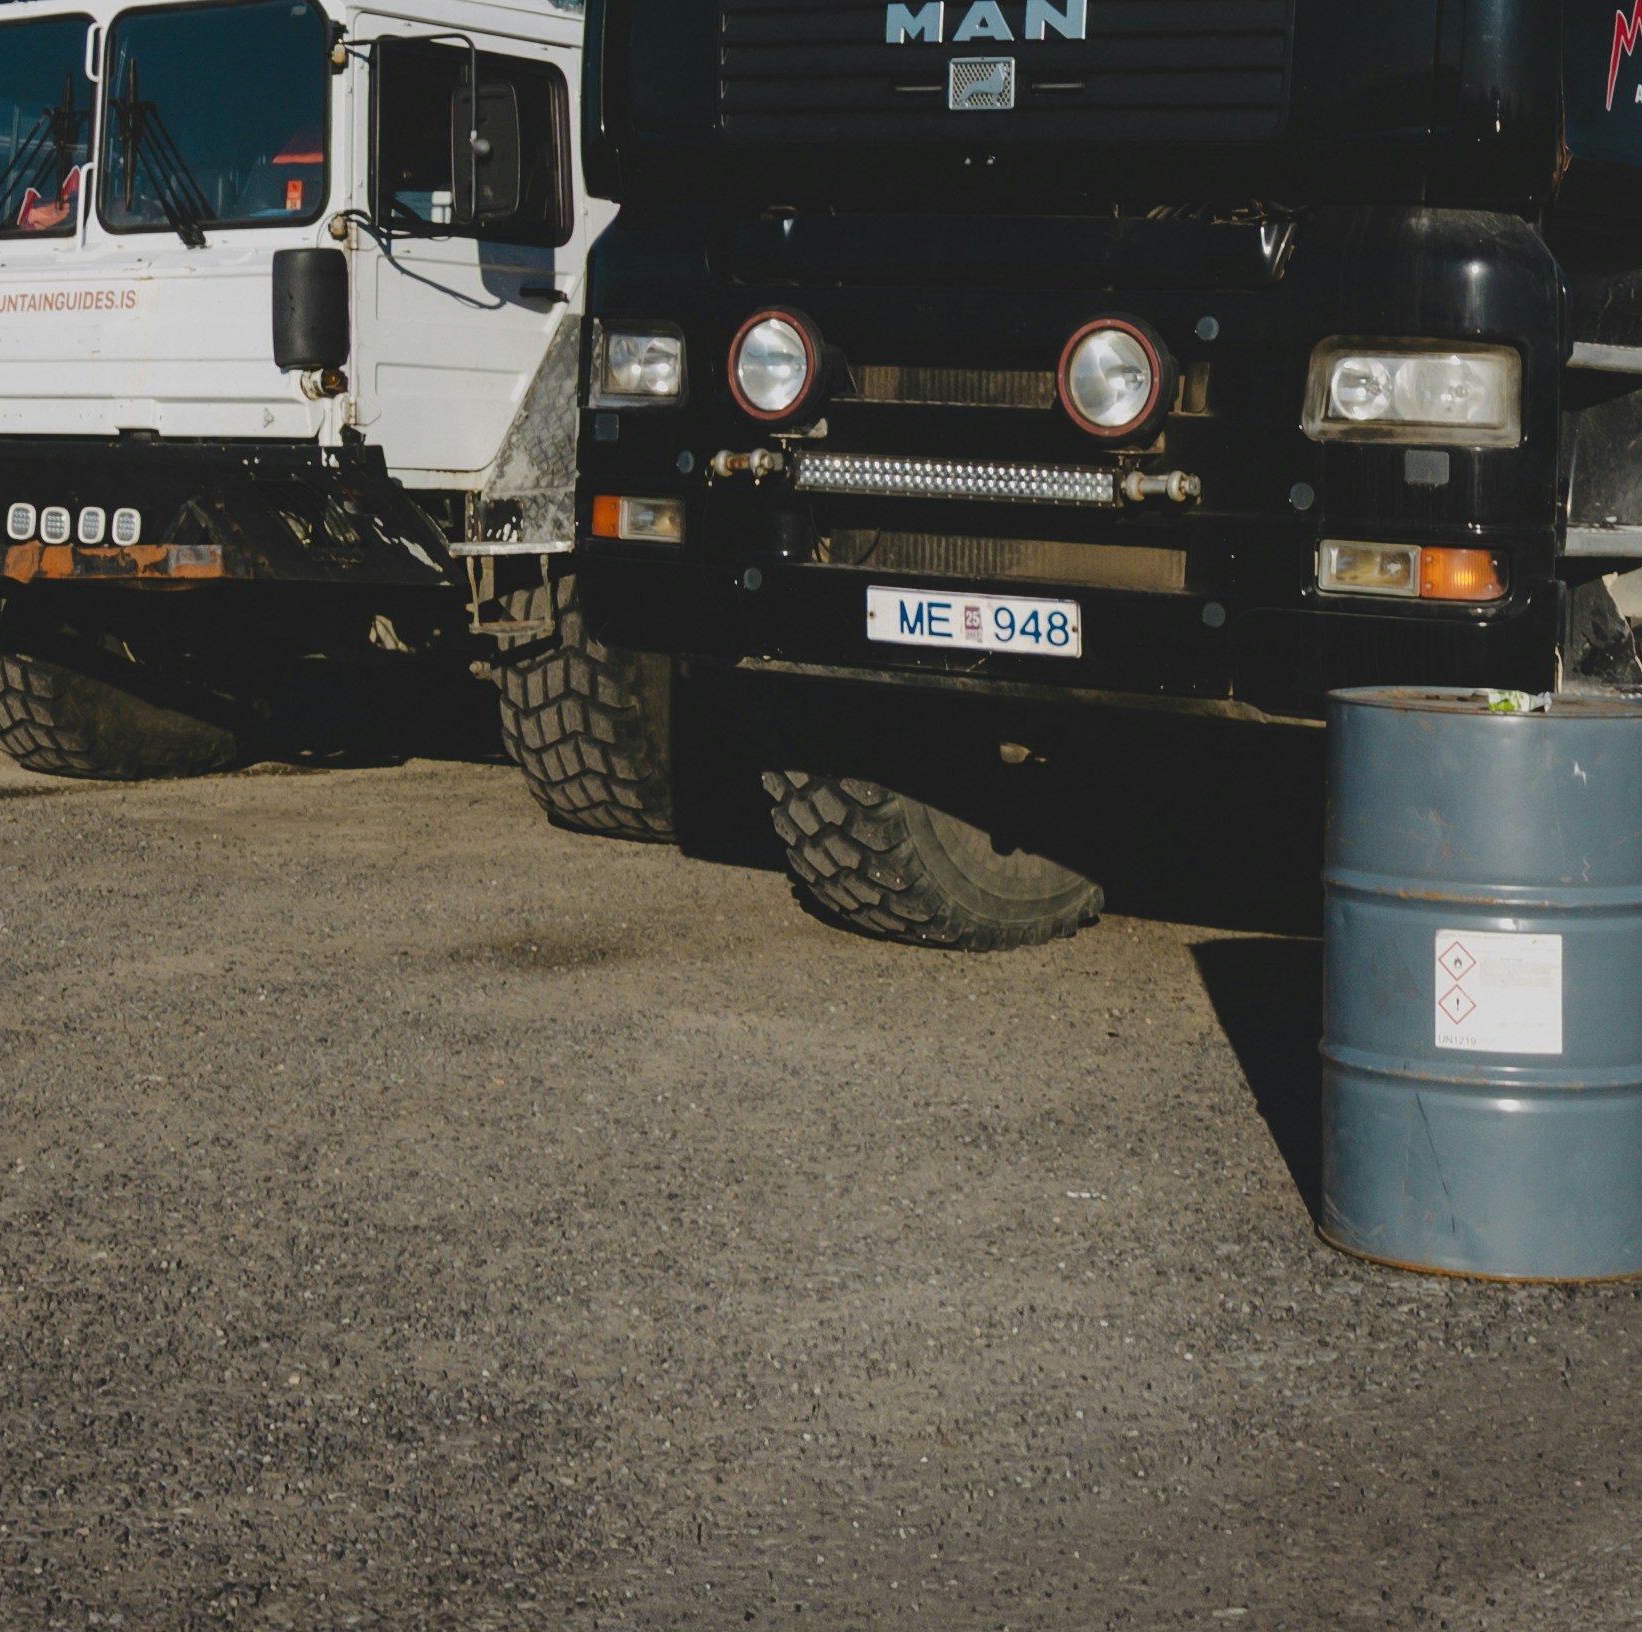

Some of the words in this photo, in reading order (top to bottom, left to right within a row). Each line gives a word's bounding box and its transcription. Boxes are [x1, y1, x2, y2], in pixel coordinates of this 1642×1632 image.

[899, 599, 954, 639] ME
[993, 606, 1070, 647] 948
[965, 609, 981, 627] 25
